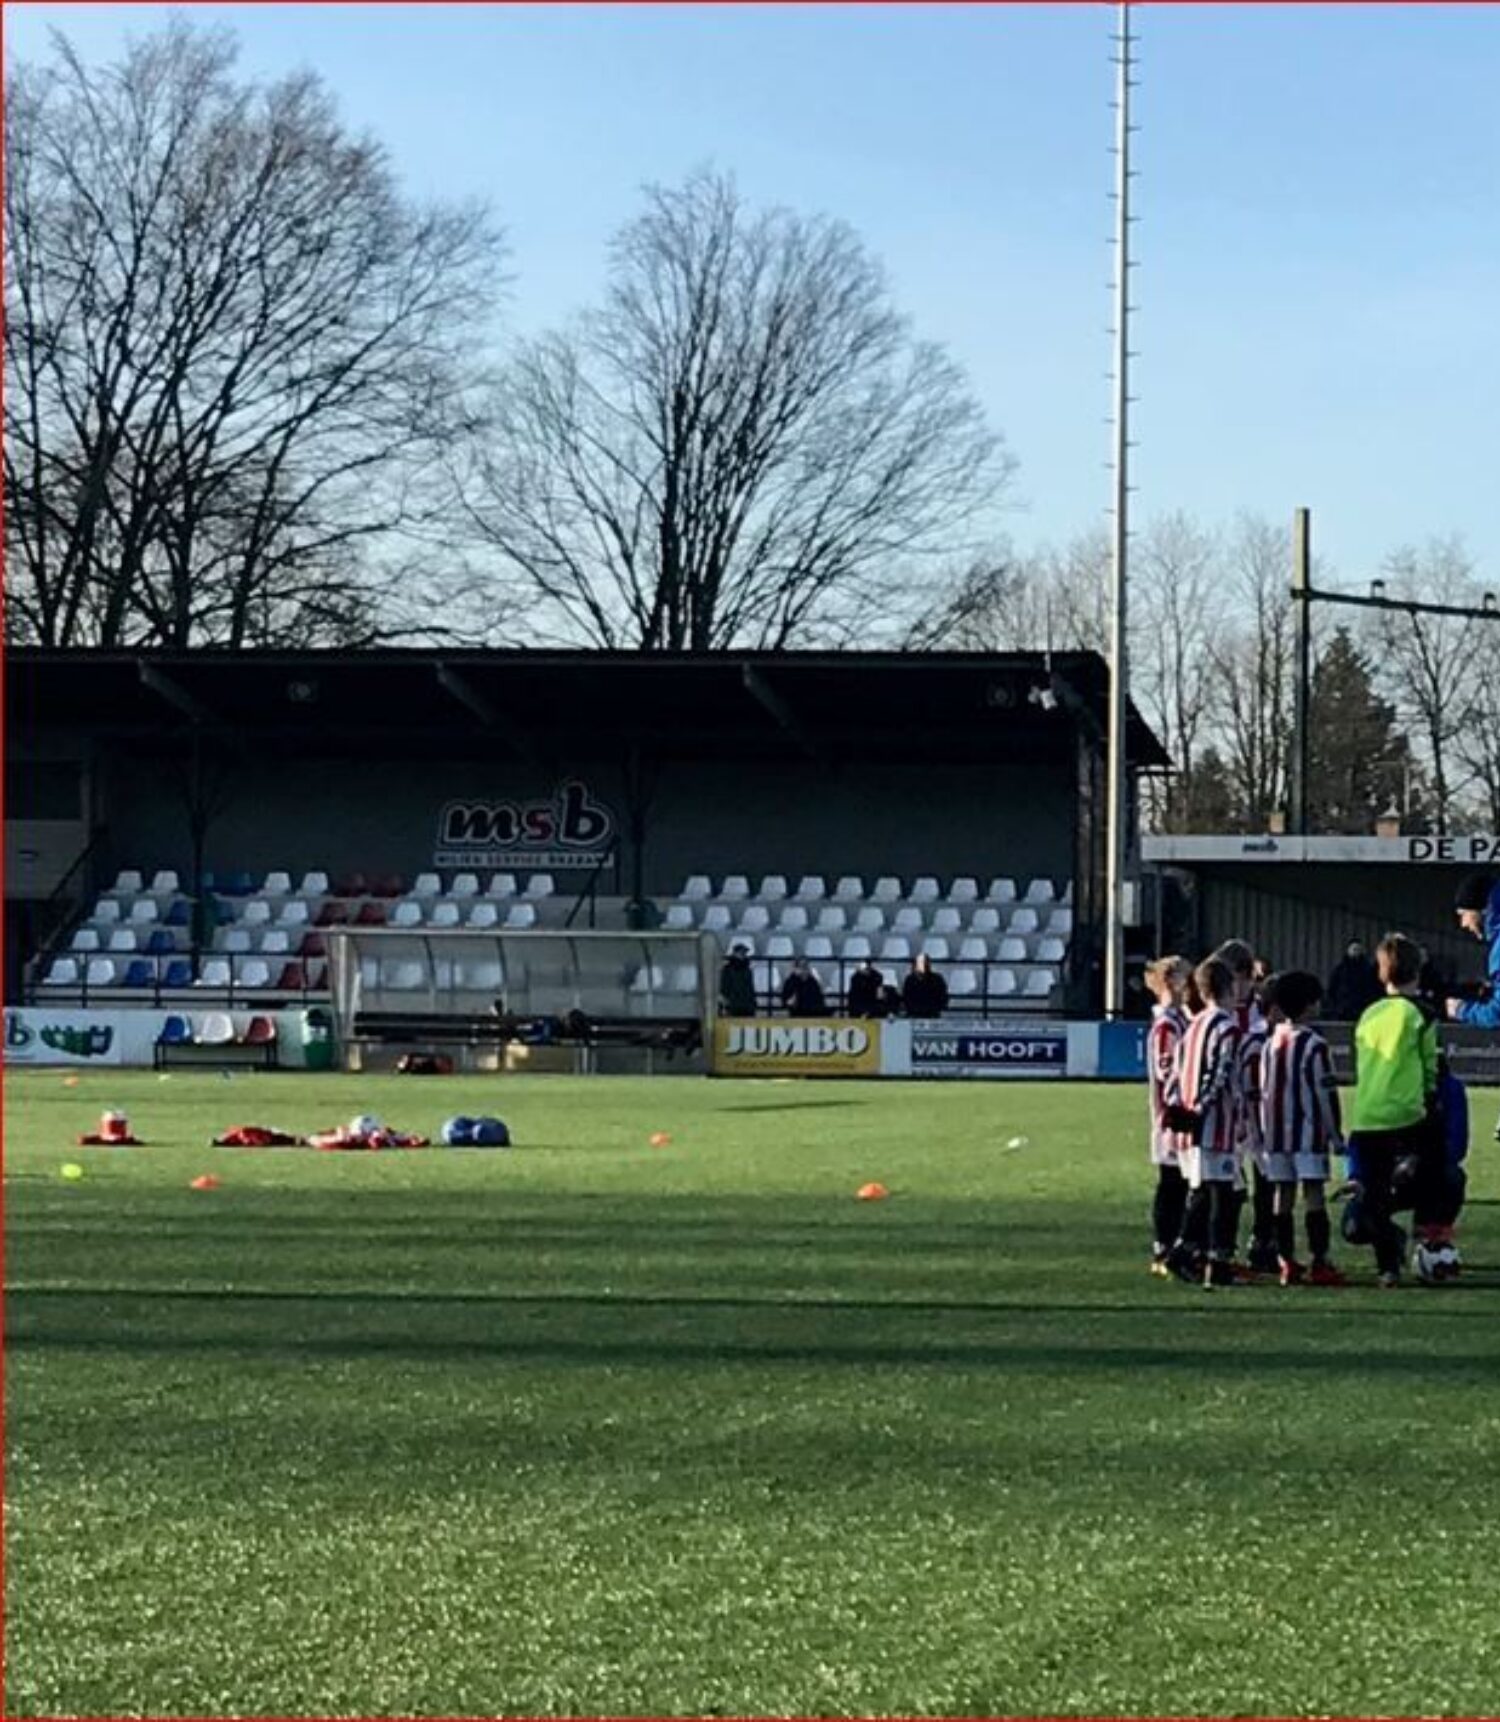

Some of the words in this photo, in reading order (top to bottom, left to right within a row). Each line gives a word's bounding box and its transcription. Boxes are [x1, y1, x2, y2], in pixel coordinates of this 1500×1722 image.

[443, 781, 611, 845] msb
[1409, 838, 1456, 861] DE
[725, 1025, 869, 1056] JUMBO
[913, 1040, 959, 1057] VAN
[967, 1041, 1060, 1059] HOOFT
